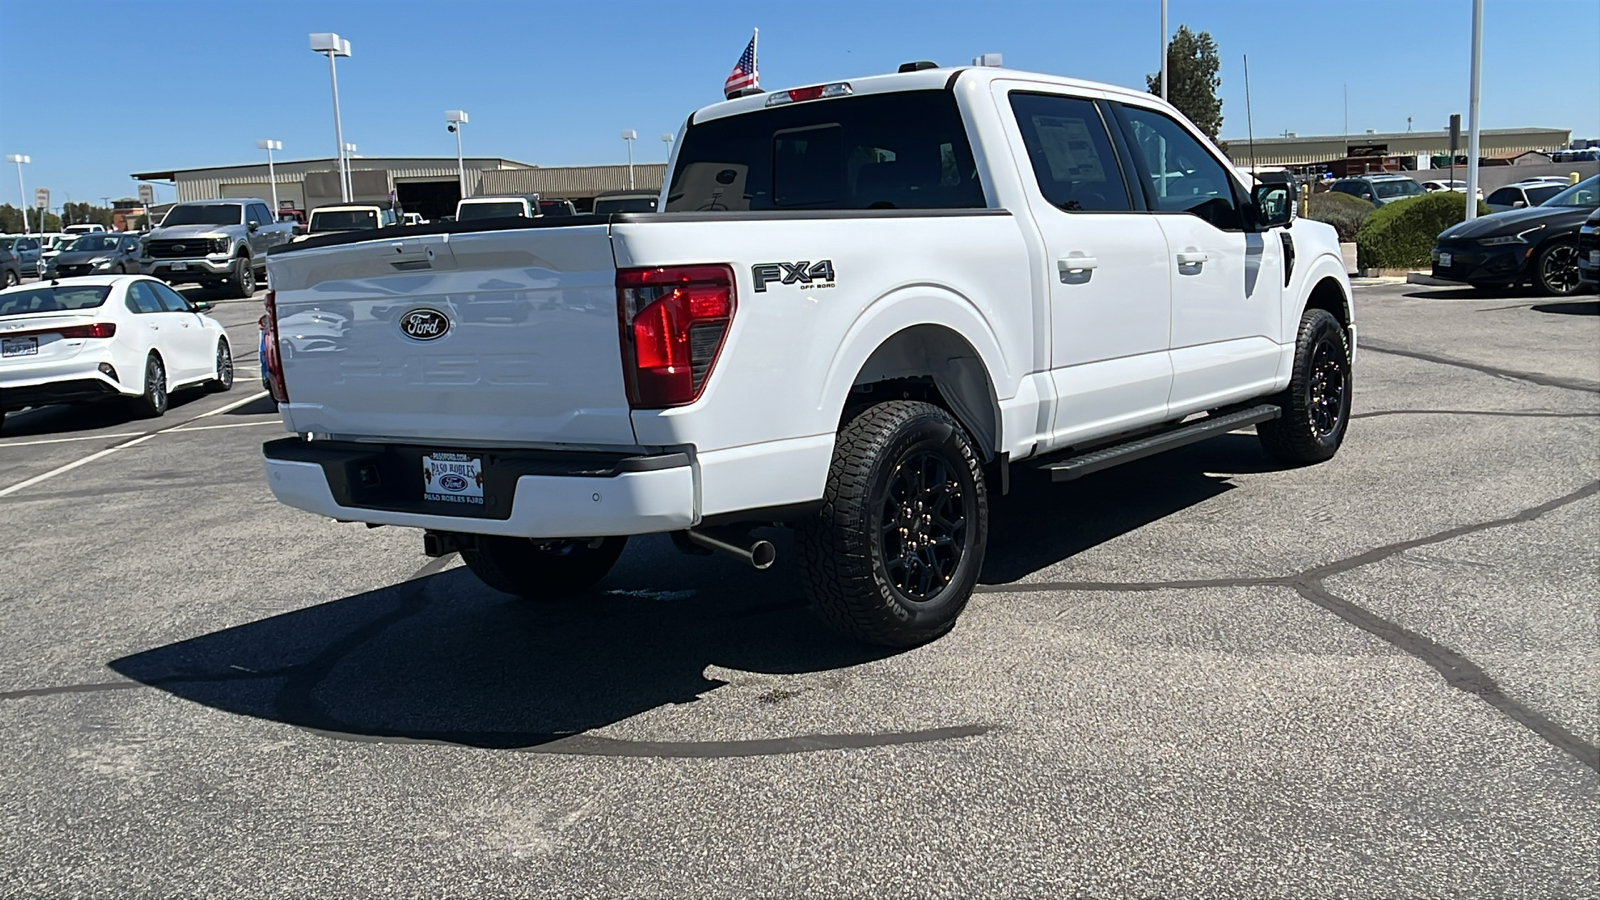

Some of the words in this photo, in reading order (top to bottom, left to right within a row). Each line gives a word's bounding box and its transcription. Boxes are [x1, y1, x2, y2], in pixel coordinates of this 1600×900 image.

[751, 260, 835, 293] FX4
[407, 313, 439, 335] Ford
[431, 462, 447, 476] PASO
[449, 464, 476, 479] ROBLES
[444, 477, 463, 488] Ford
[424, 493, 440, 501] PASO
[441, 495, 465, 503] ROBLES
[466, 496, 483, 505] FORD
